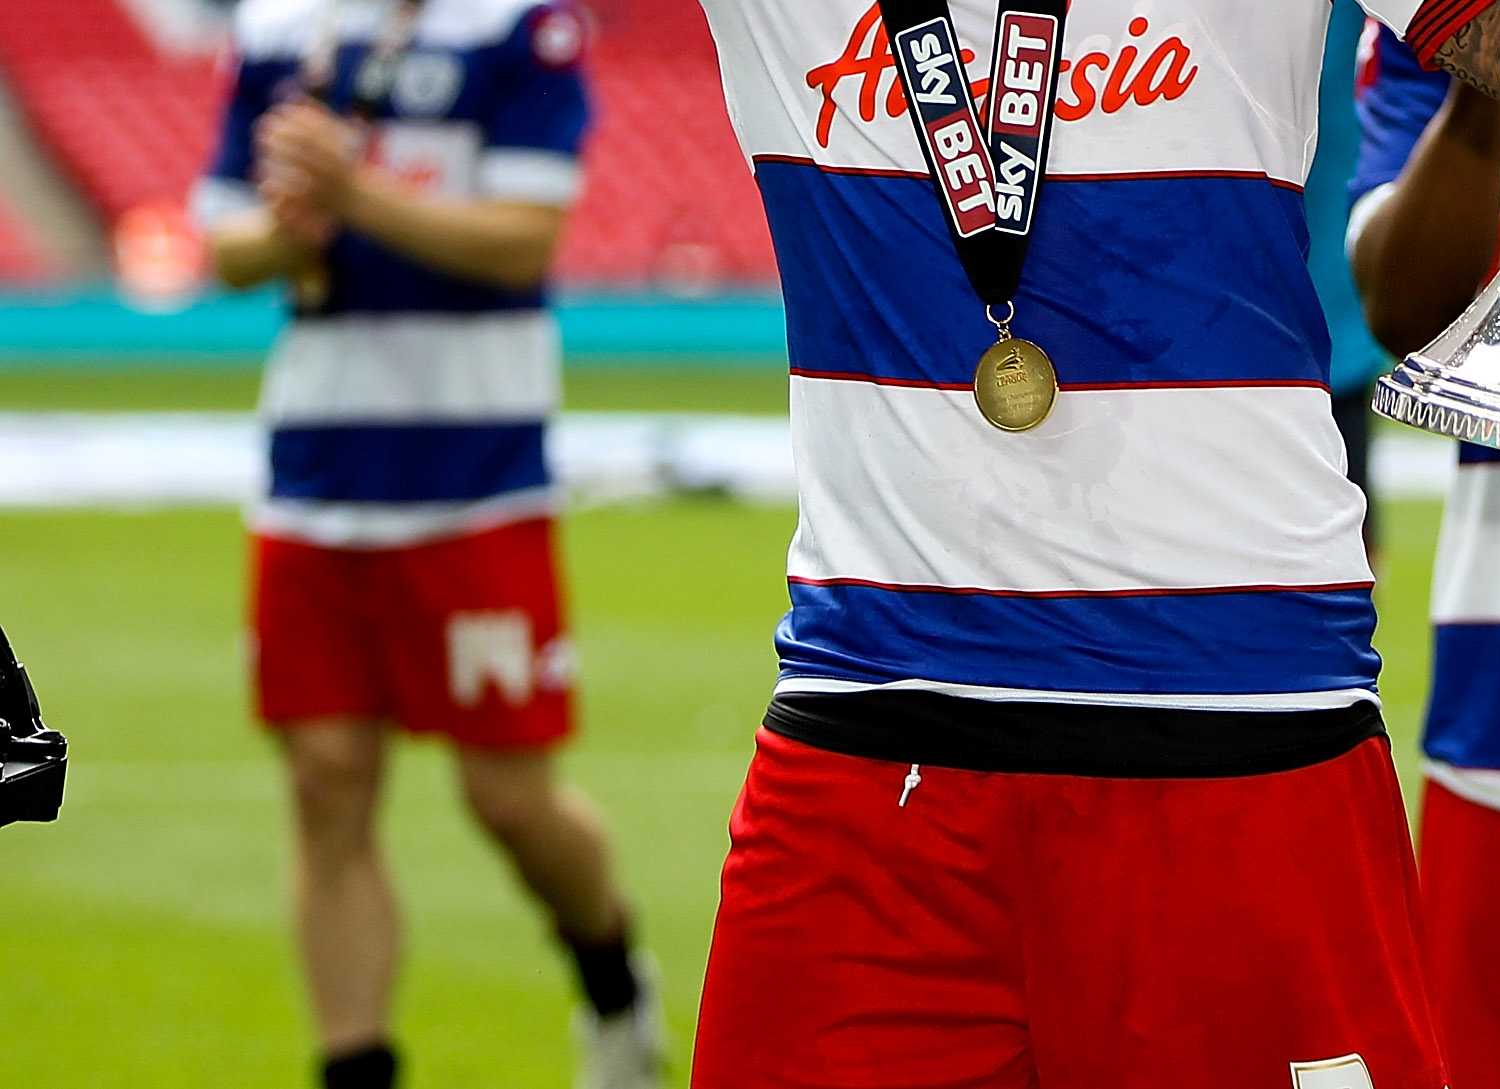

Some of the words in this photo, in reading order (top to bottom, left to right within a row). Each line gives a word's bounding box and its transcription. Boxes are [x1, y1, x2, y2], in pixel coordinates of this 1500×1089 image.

[909, 32, 957, 105] sky
[999, 23, 1048, 128] BET
[932, 119, 996, 214] BET
[996, 141, 1035, 222] sky
